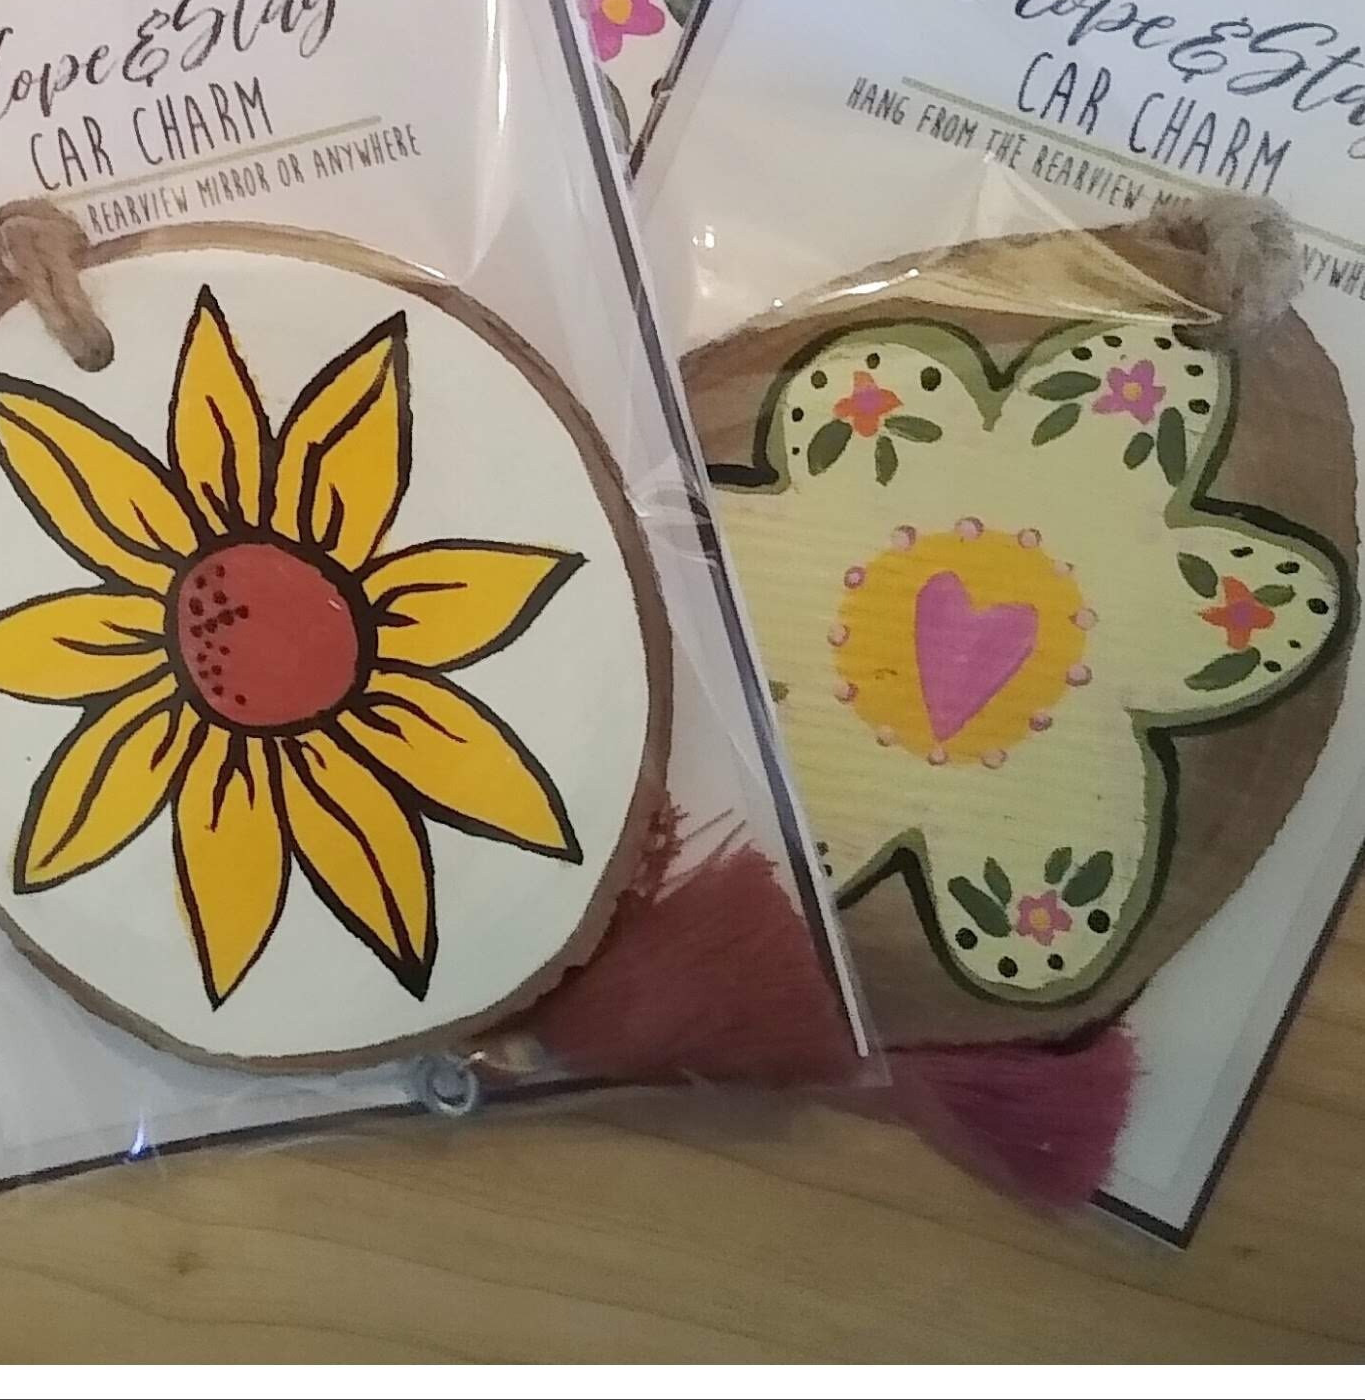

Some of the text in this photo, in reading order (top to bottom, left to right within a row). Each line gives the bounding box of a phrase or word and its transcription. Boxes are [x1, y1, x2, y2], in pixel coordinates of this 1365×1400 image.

[30, 76, 274, 192] CAR CHARM
[87, 192, 189, 235] REARVIEW
[197, 162, 271, 208] MIRROR
[278, 155, 305, 188] OR
[313, 123, 422, 179] ANYWHERE
[846, 76, 910, 126] HANG
[915, 103, 979, 152] FROM
[985, 130, 1028, 171] THE
[1034, 143, 1145, 211] REARVIEW
[1018, 51, 1293, 196] CAR CHARM
